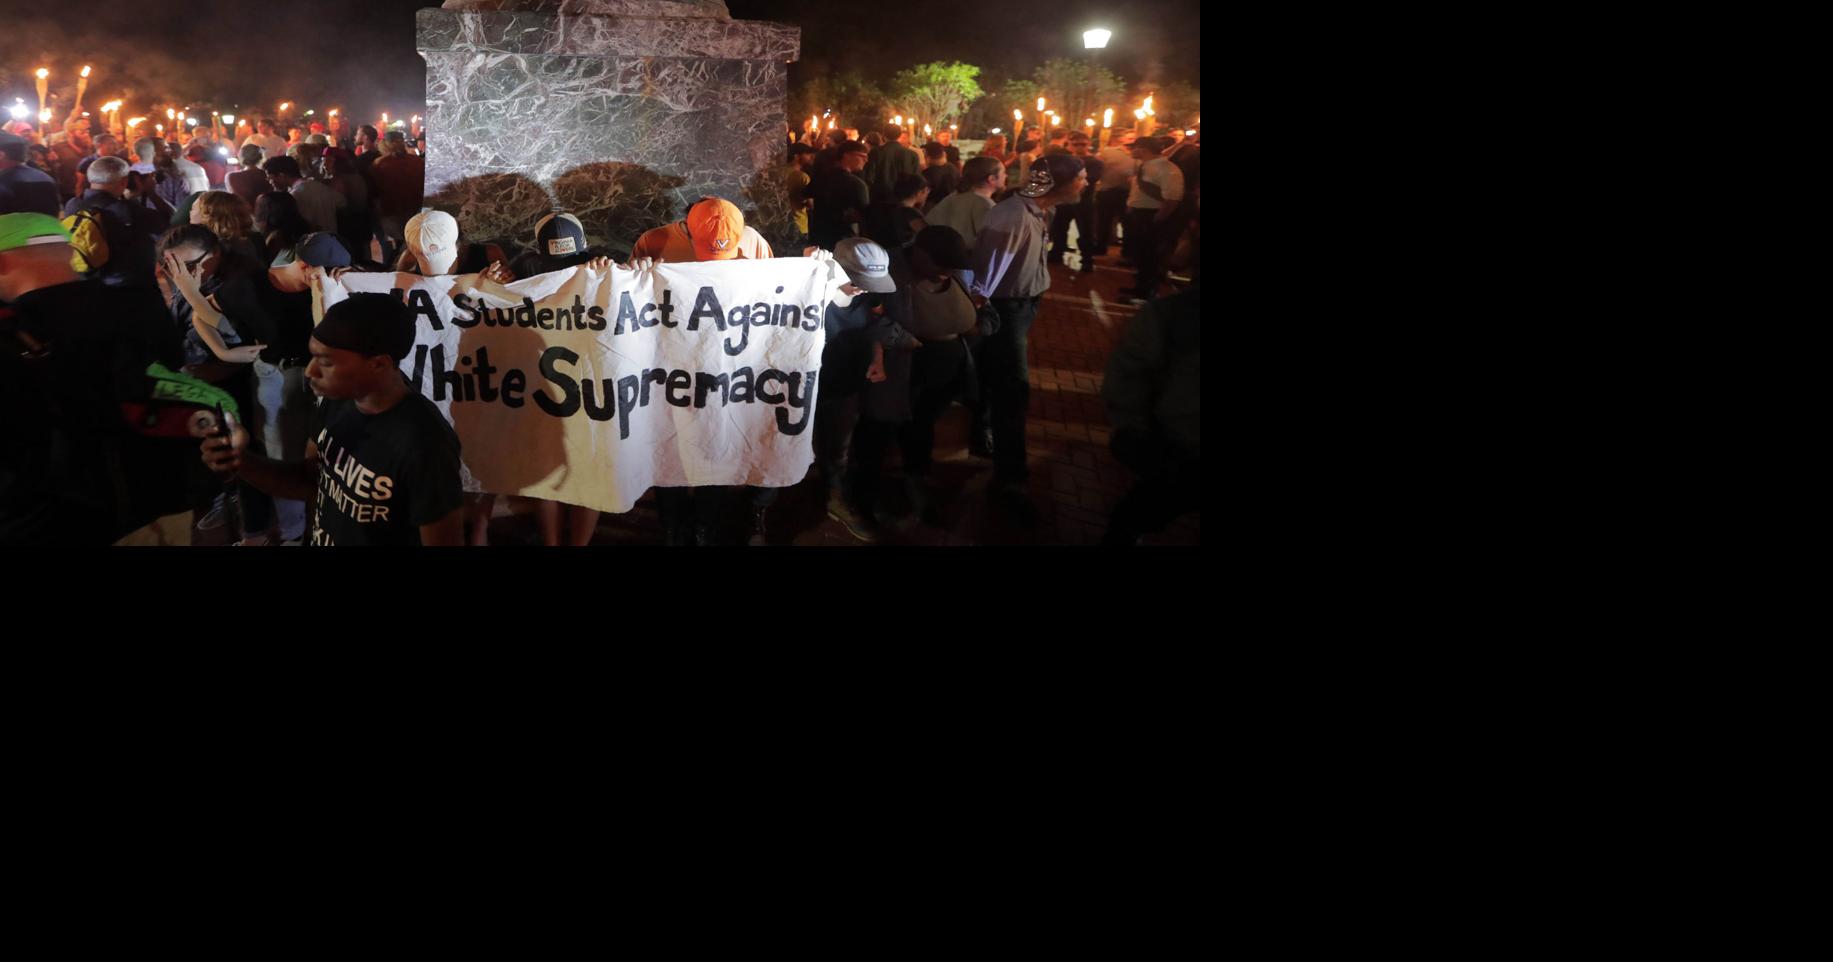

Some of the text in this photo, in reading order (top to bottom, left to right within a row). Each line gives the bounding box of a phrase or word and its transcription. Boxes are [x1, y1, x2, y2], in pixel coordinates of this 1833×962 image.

[390, 288, 444, 331] A
[451, 294, 606, 330] Students
[614, 289, 678, 336] Act
[532, 346, 817, 439] Supremacy
[334, 447, 393, 500] LIVES
[329, 480, 389, 522] MATTER
